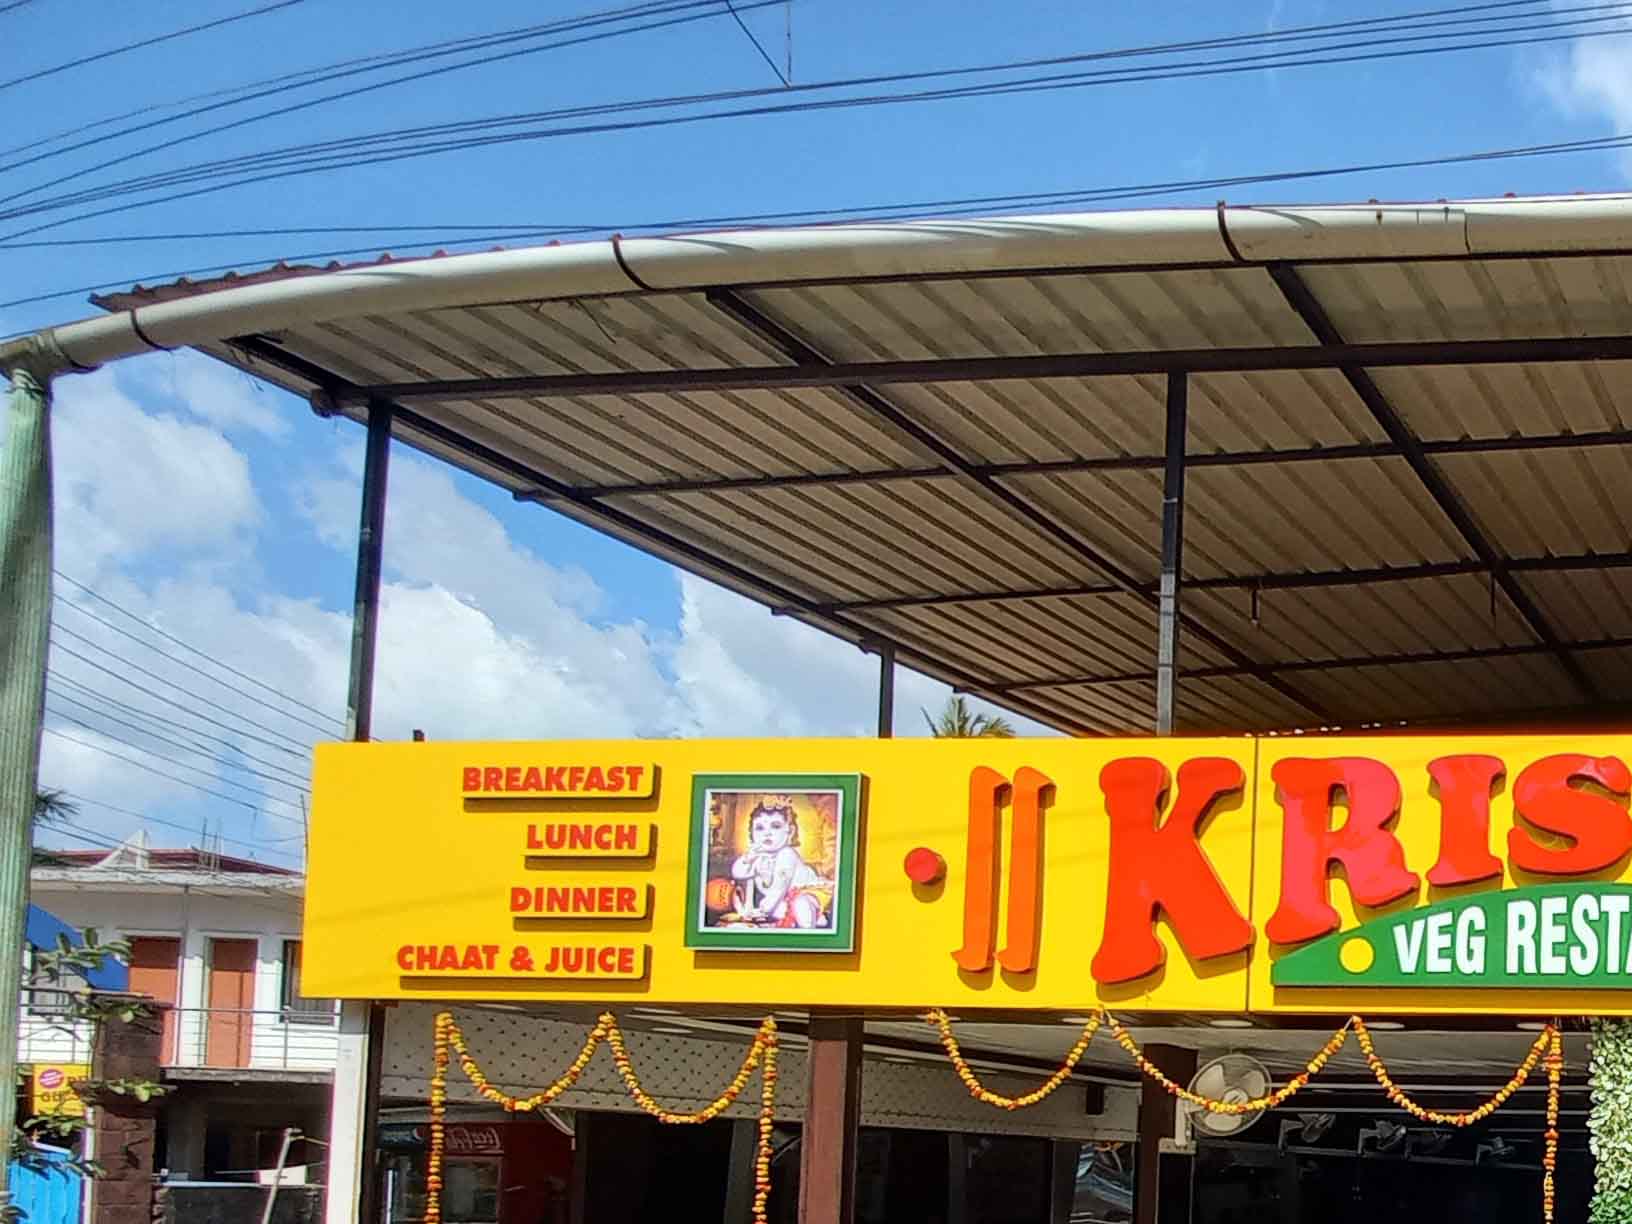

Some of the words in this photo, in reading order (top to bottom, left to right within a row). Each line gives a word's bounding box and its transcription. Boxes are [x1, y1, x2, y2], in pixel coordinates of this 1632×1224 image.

[463, 766, 644, 792] BREAKFAST
[527, 824, 637, 850] LUNCH
[510, 887, 637, 913] DINNER
[1392, 905, 1487, 975] VEG
[397, 944, 499, 971] CHAAT
[510, 946, 534, 972] &
[546, 946, 634, 973] JUICE
